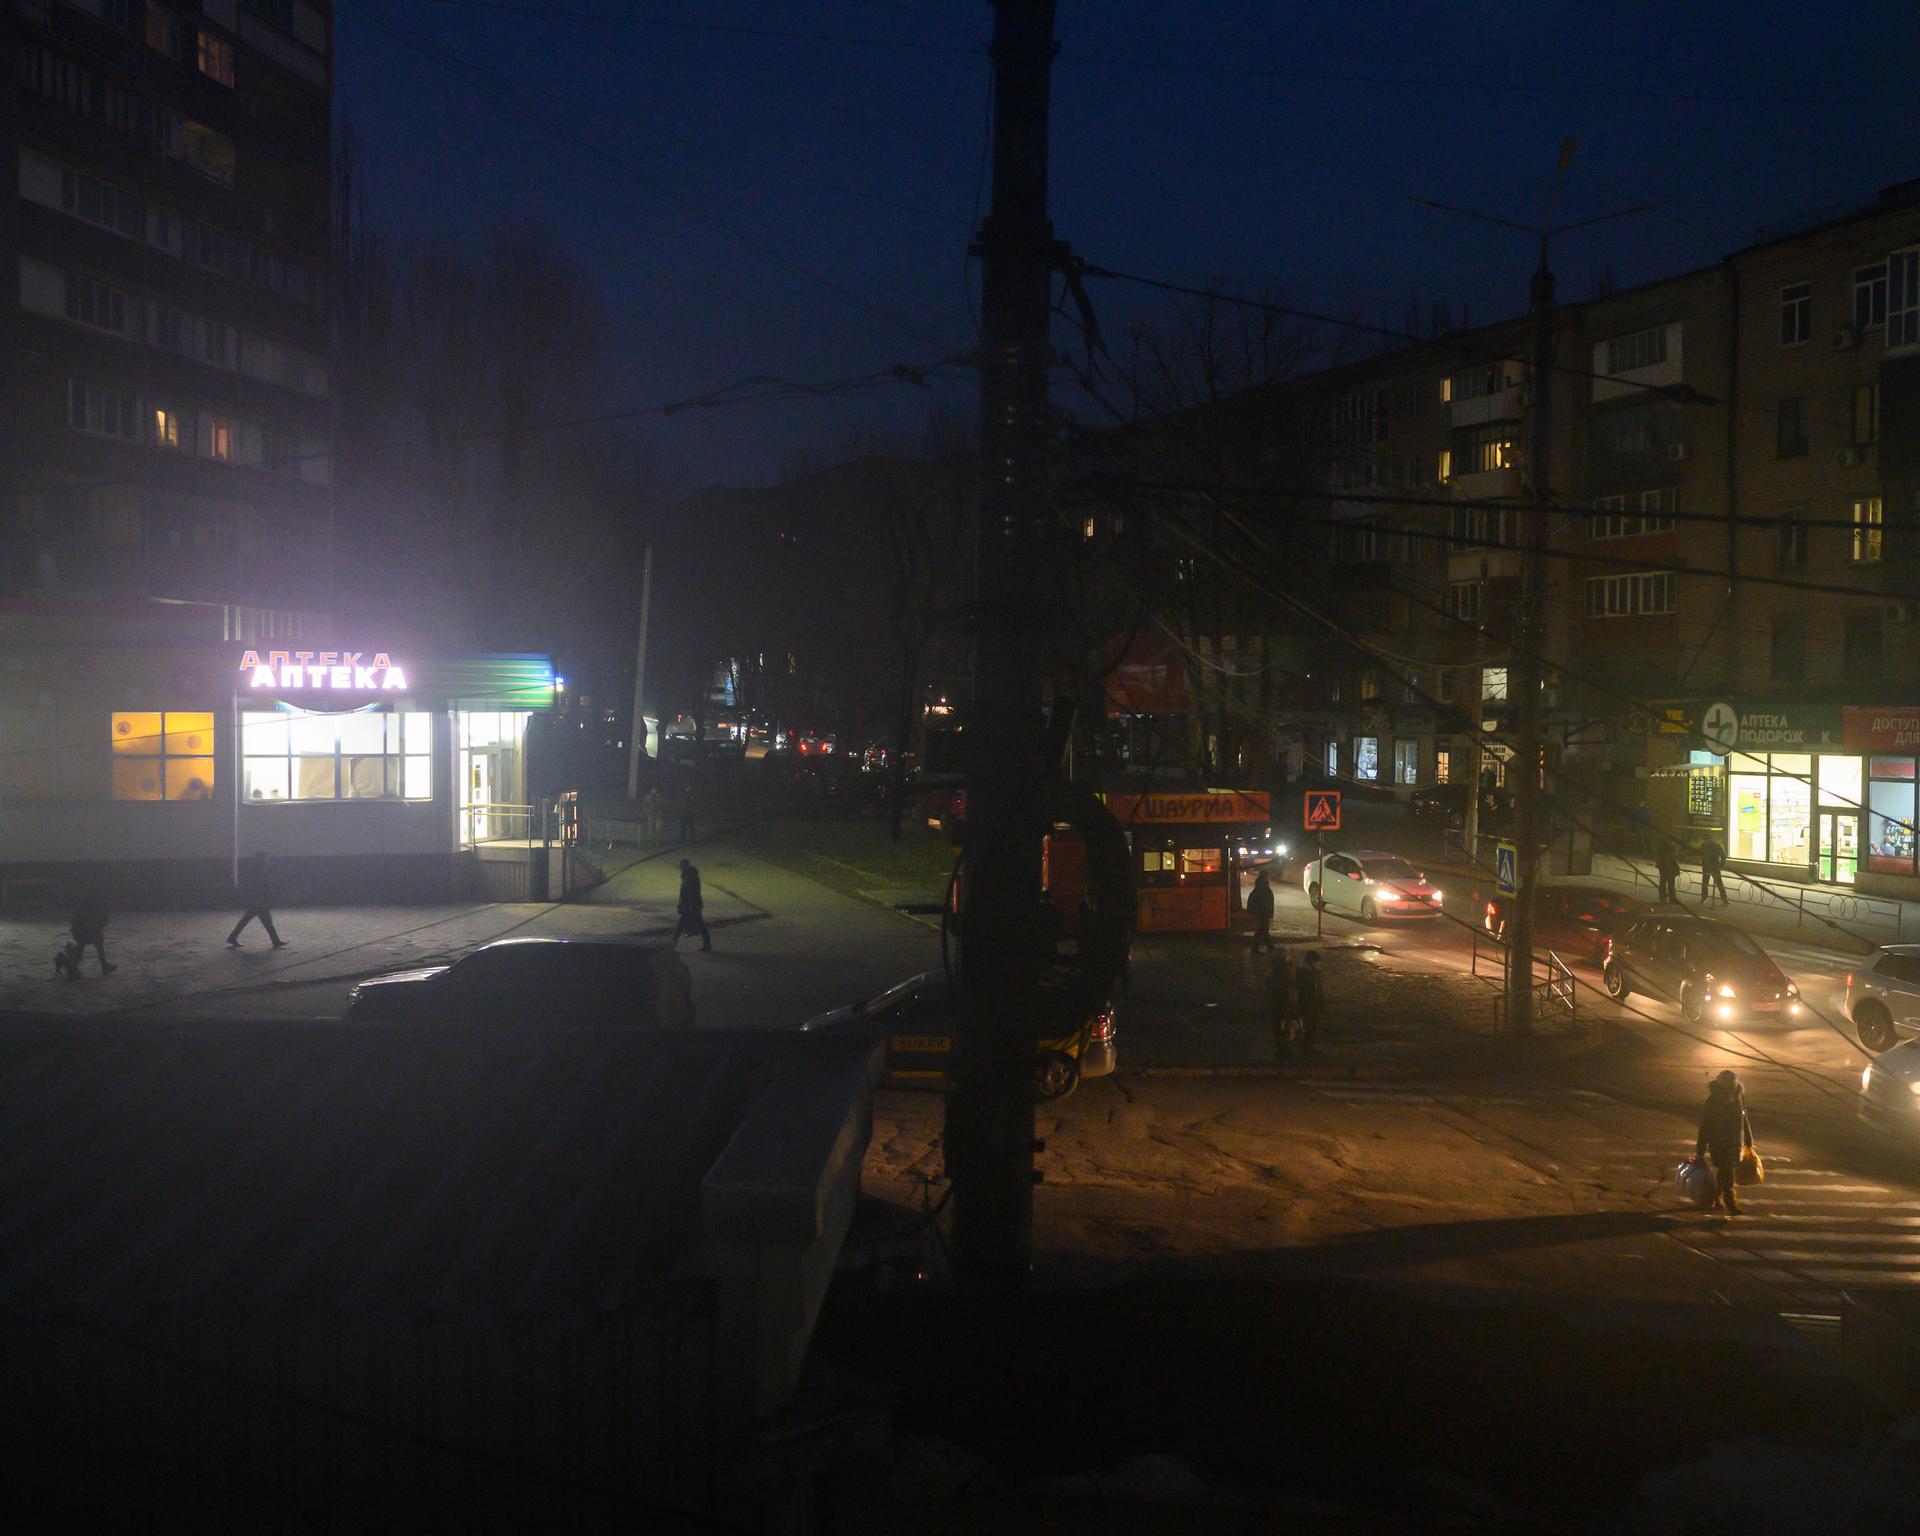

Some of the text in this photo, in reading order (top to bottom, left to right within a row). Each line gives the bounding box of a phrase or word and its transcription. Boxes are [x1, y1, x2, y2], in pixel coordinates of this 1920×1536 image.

[250, 665, 408, 689] АПТЕКА
[1740, 715, 1788, 728] АПТЕКА
[1894, 731, 1920, 746] ДЛЯ
[1145, 799, 1233, 818] ШАУРМА
[897, 1038, 945, 1049] SHARK
